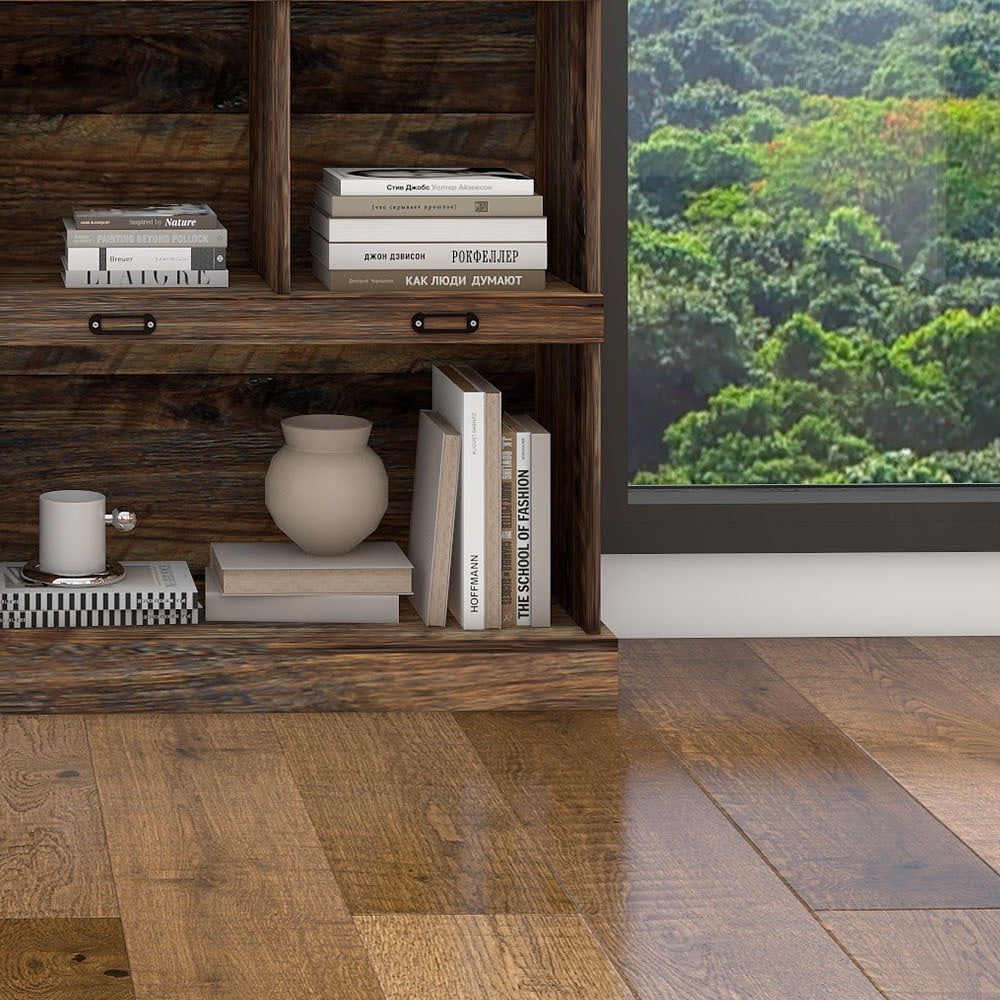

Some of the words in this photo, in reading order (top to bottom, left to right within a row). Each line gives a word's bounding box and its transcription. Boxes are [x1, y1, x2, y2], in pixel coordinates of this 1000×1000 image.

[129, 218, 154, 227] Inspired
[154, 218, 162, 227] by
[164, 218, 197, 227] Nature
[97, 234, 135, 244] PAINTING
[172, 234, 209, 244] POLLOCK
[364, 252, 387, 261] ДЖОН
[451, 250, 519, 264] РОКФЕЛЛЕР
[405, 275, 429, 286] КАК
[430, 275, 466, 287] ЛЮДИ
[472, 275, 523, 287] ДУМАЮТ
[517, 469, 529, 522] FASHION
[517, 524, 530, 541] OF
[517, 543, 530, 593] SCHOOL
[470, 554, 478, 613] HOFFMANN
[517, 594, 529, 620] THE
